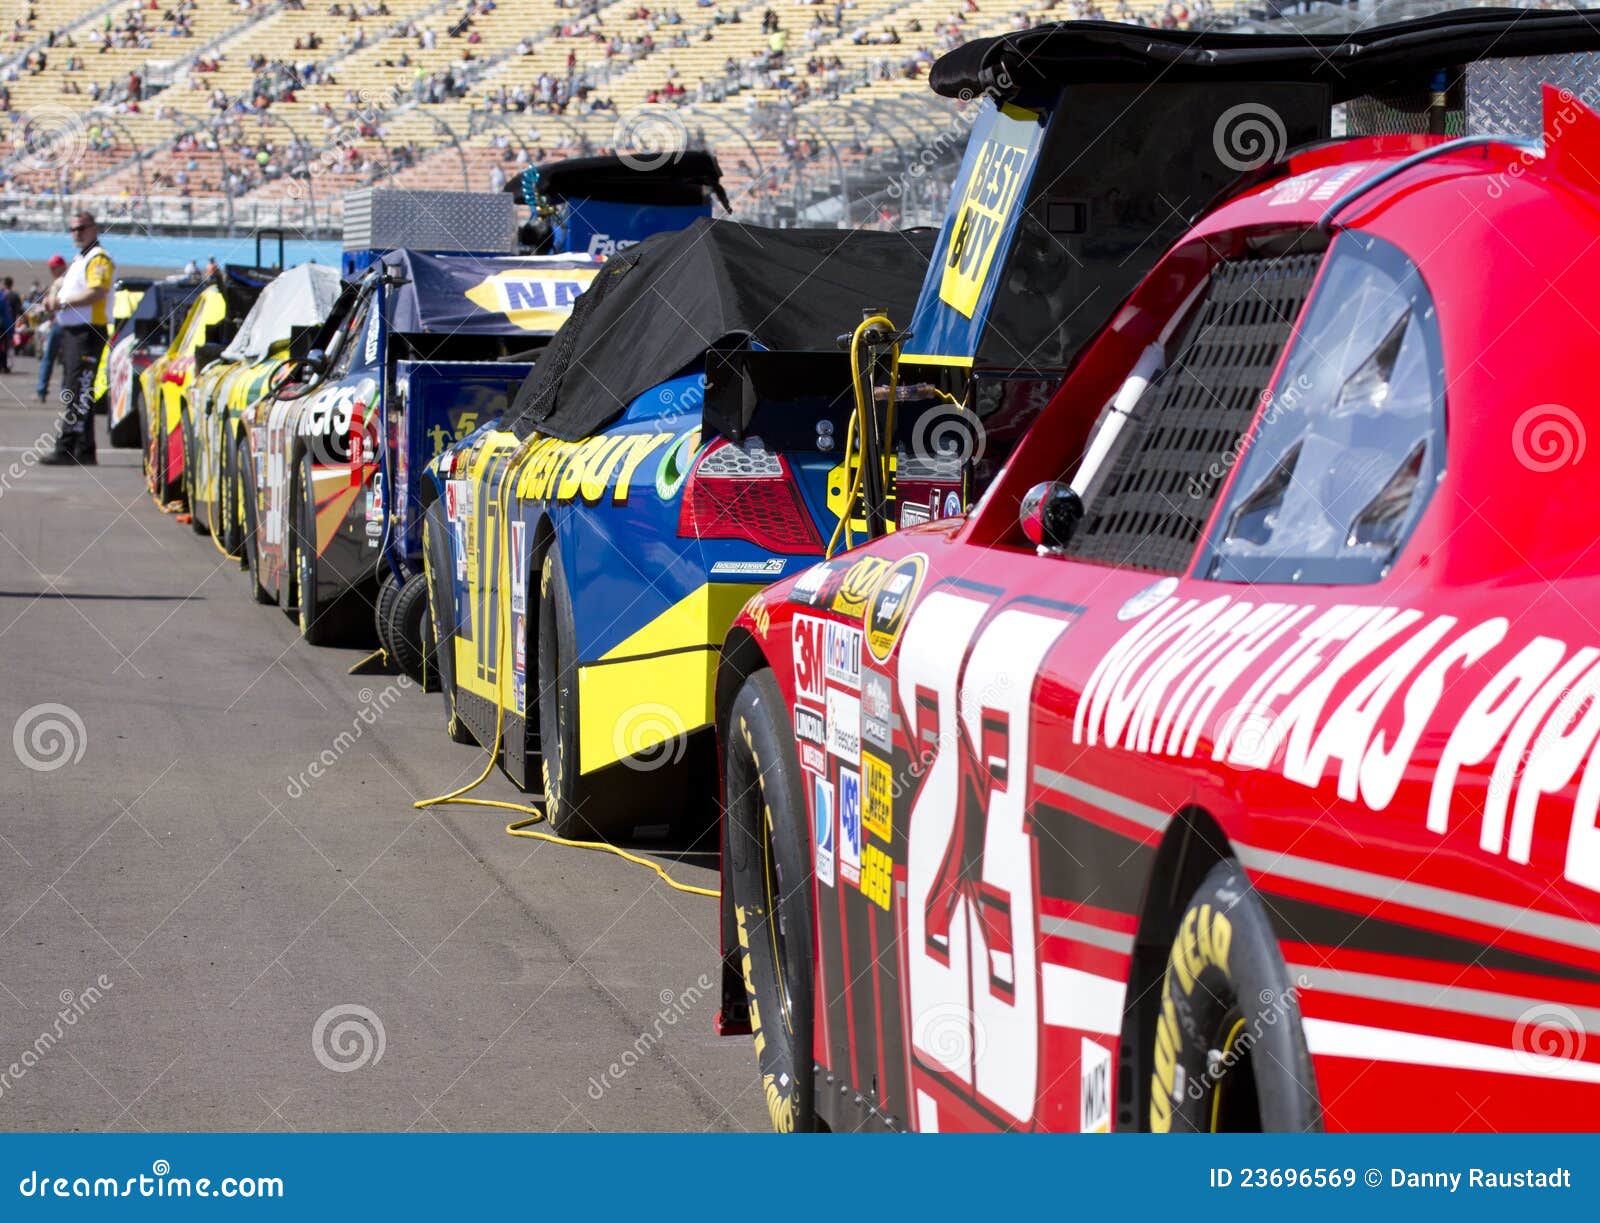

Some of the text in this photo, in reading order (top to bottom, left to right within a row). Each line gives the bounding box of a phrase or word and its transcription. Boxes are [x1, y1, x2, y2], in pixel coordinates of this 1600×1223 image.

[969, 139, 1027, 215] BEST
[948, 206, 1000, 282] BUY
[557, 432, 676, 507] BUY
[795, 618, 824, 698] 3M
[827, 623, 860, 675] Mobil 1
[864, 720, 886, 742] POLE
[1073, 595, 1306, 758] NORTH
[1211, 604, 1511, 811] TEXAS
